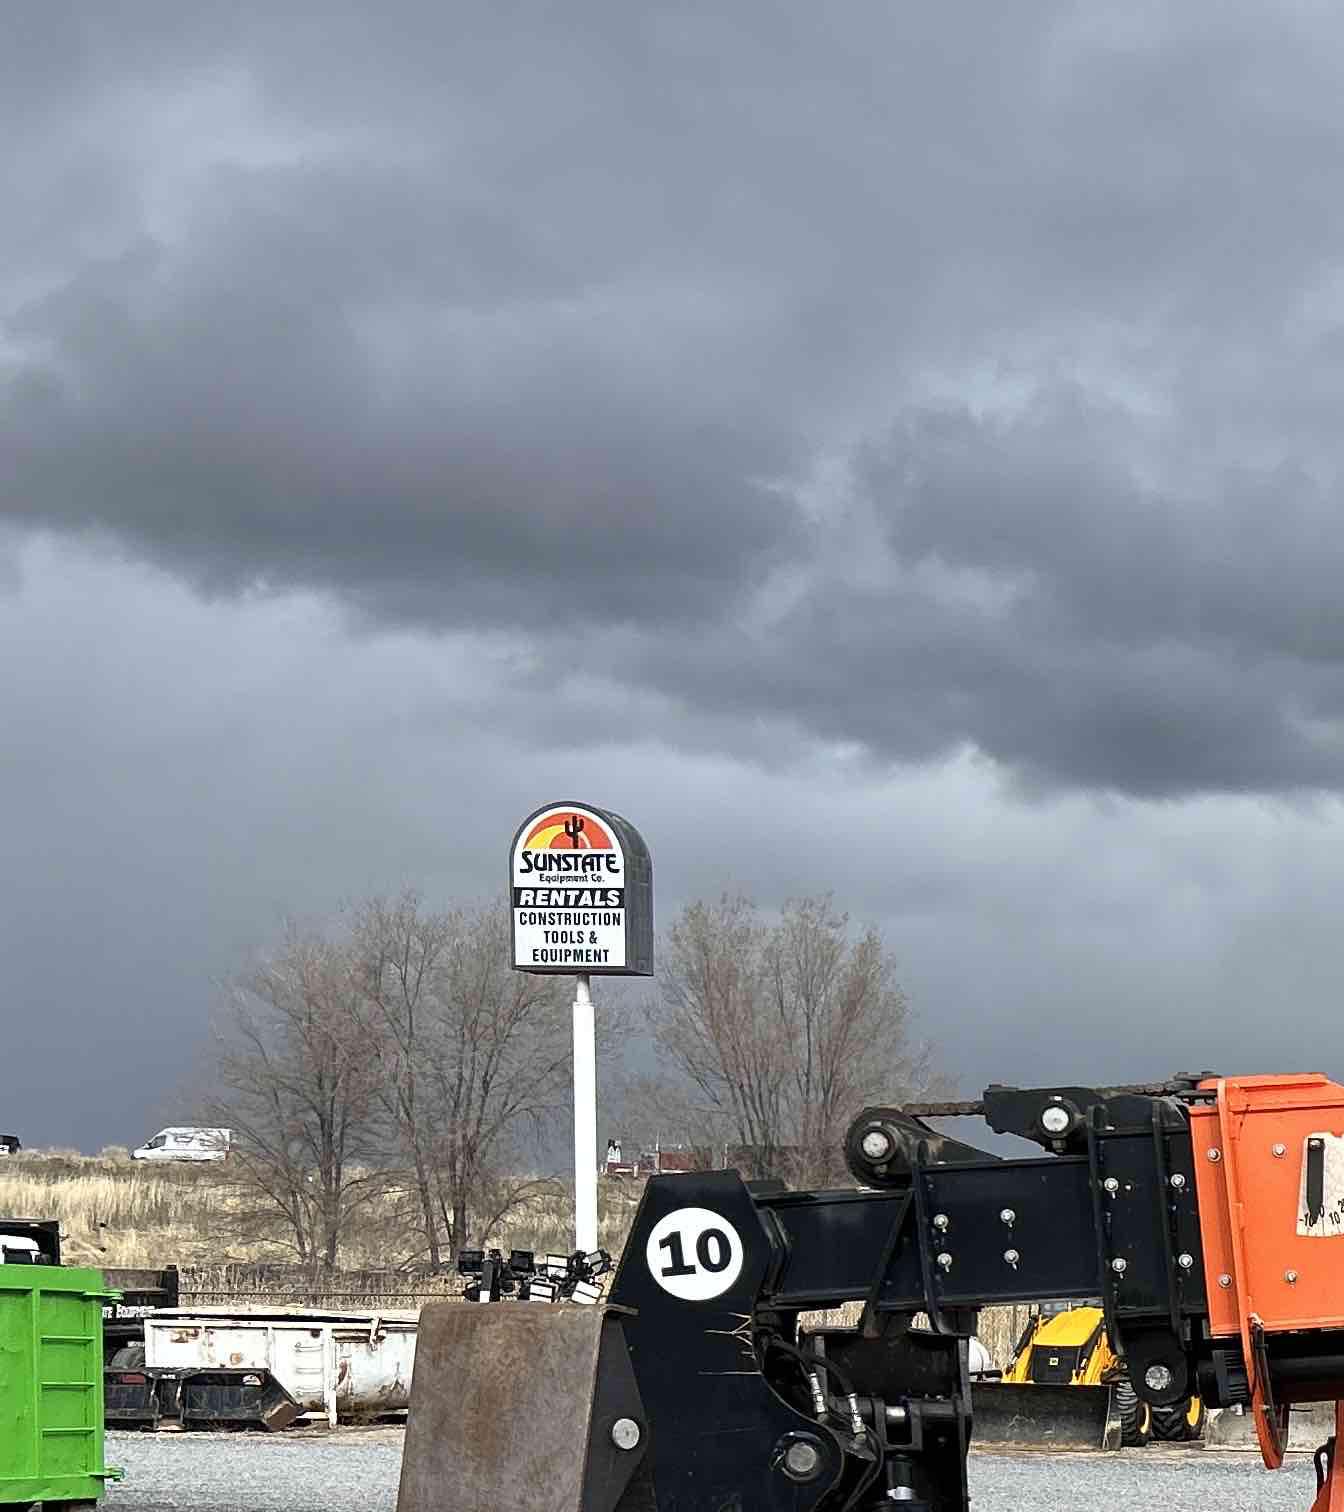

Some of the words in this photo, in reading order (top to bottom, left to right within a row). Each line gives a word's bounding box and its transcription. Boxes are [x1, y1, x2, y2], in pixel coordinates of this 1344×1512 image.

[539, 873, 588, 884] Equipment
[519, 889, 620, 907] RENTALS
[519, 912, 621, 926] CONSTRUCTION
[544, 931, 584, 944] TOOLS
[589, 931, 598, 944] &
[532, 949, 609, 963] EQUIPMENT
[1329, 1211, 1341, 1225] 10
[658, 1228, 732, 1277] 10
